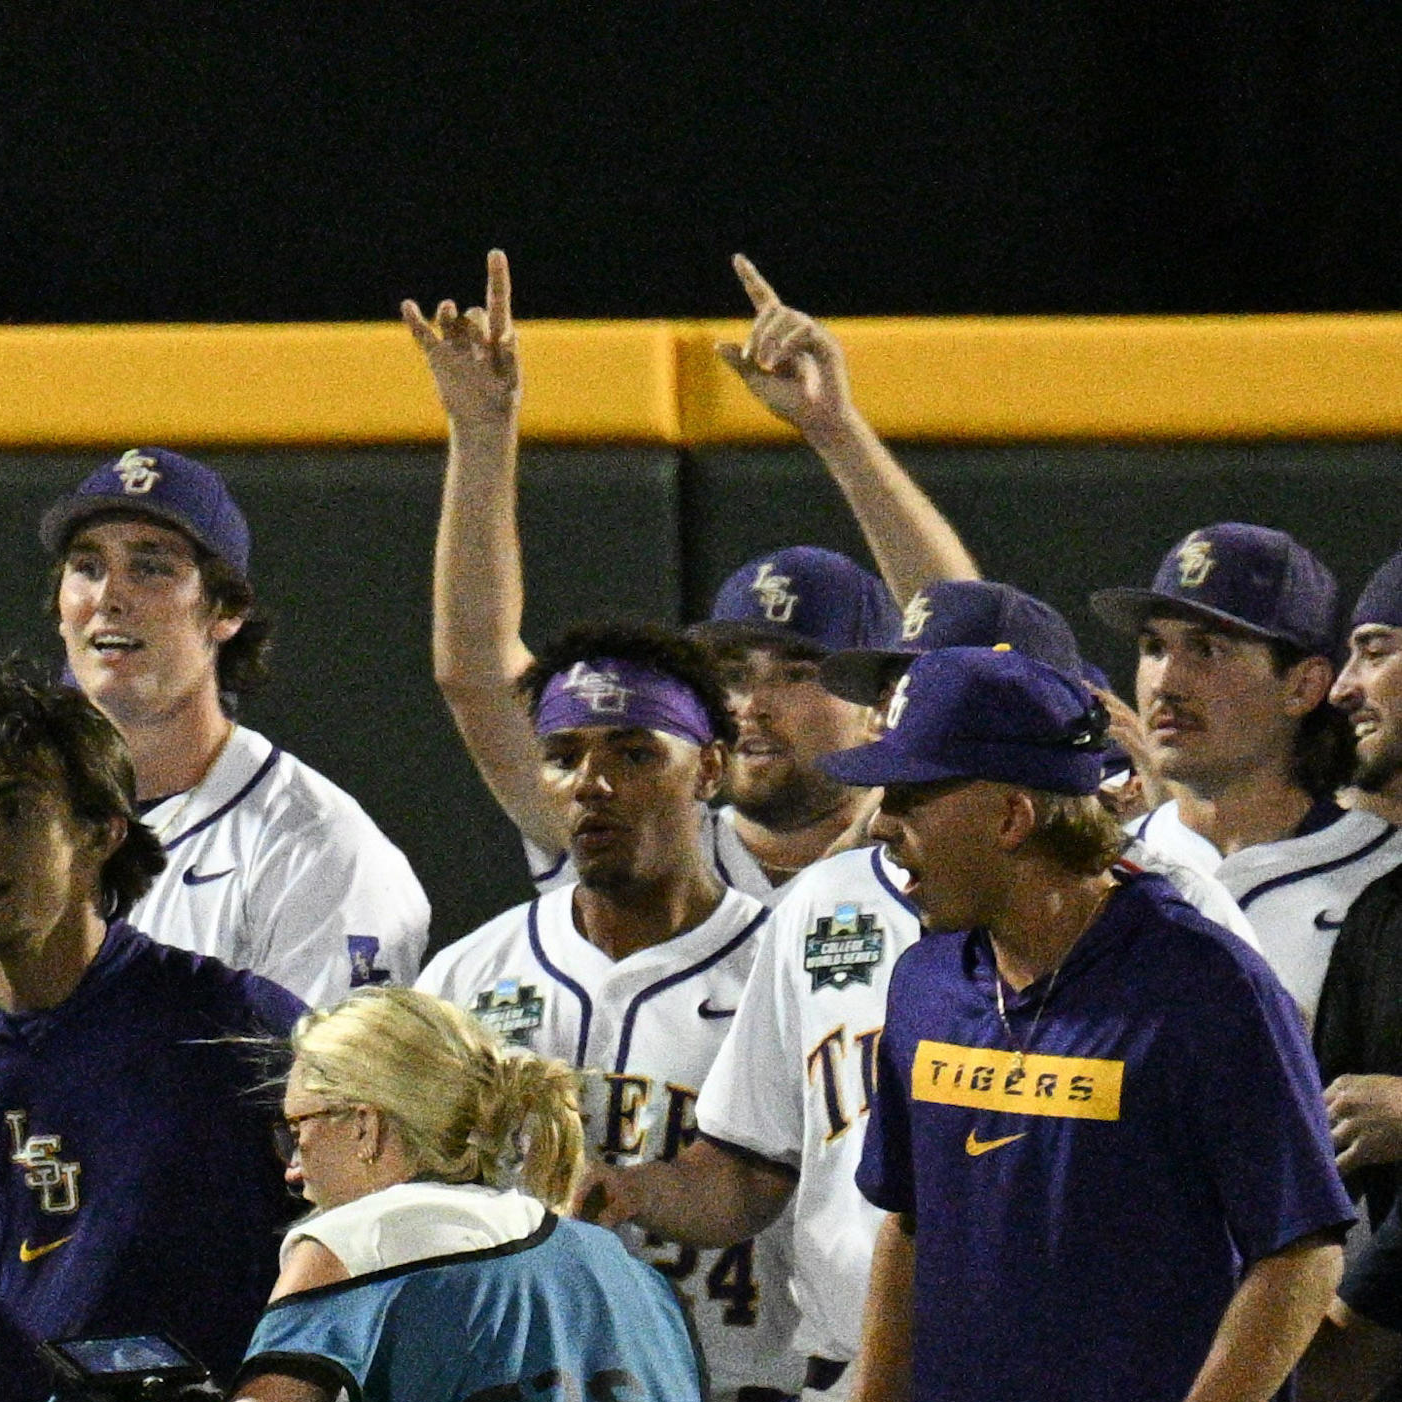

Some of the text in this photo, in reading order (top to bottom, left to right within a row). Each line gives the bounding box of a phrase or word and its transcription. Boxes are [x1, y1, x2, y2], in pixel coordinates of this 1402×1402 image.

[752, 563, 797, 622] LSU
[931, 1060, 1094, 1101] TIGERS
[4, 1110, 81, 1215] LSU
